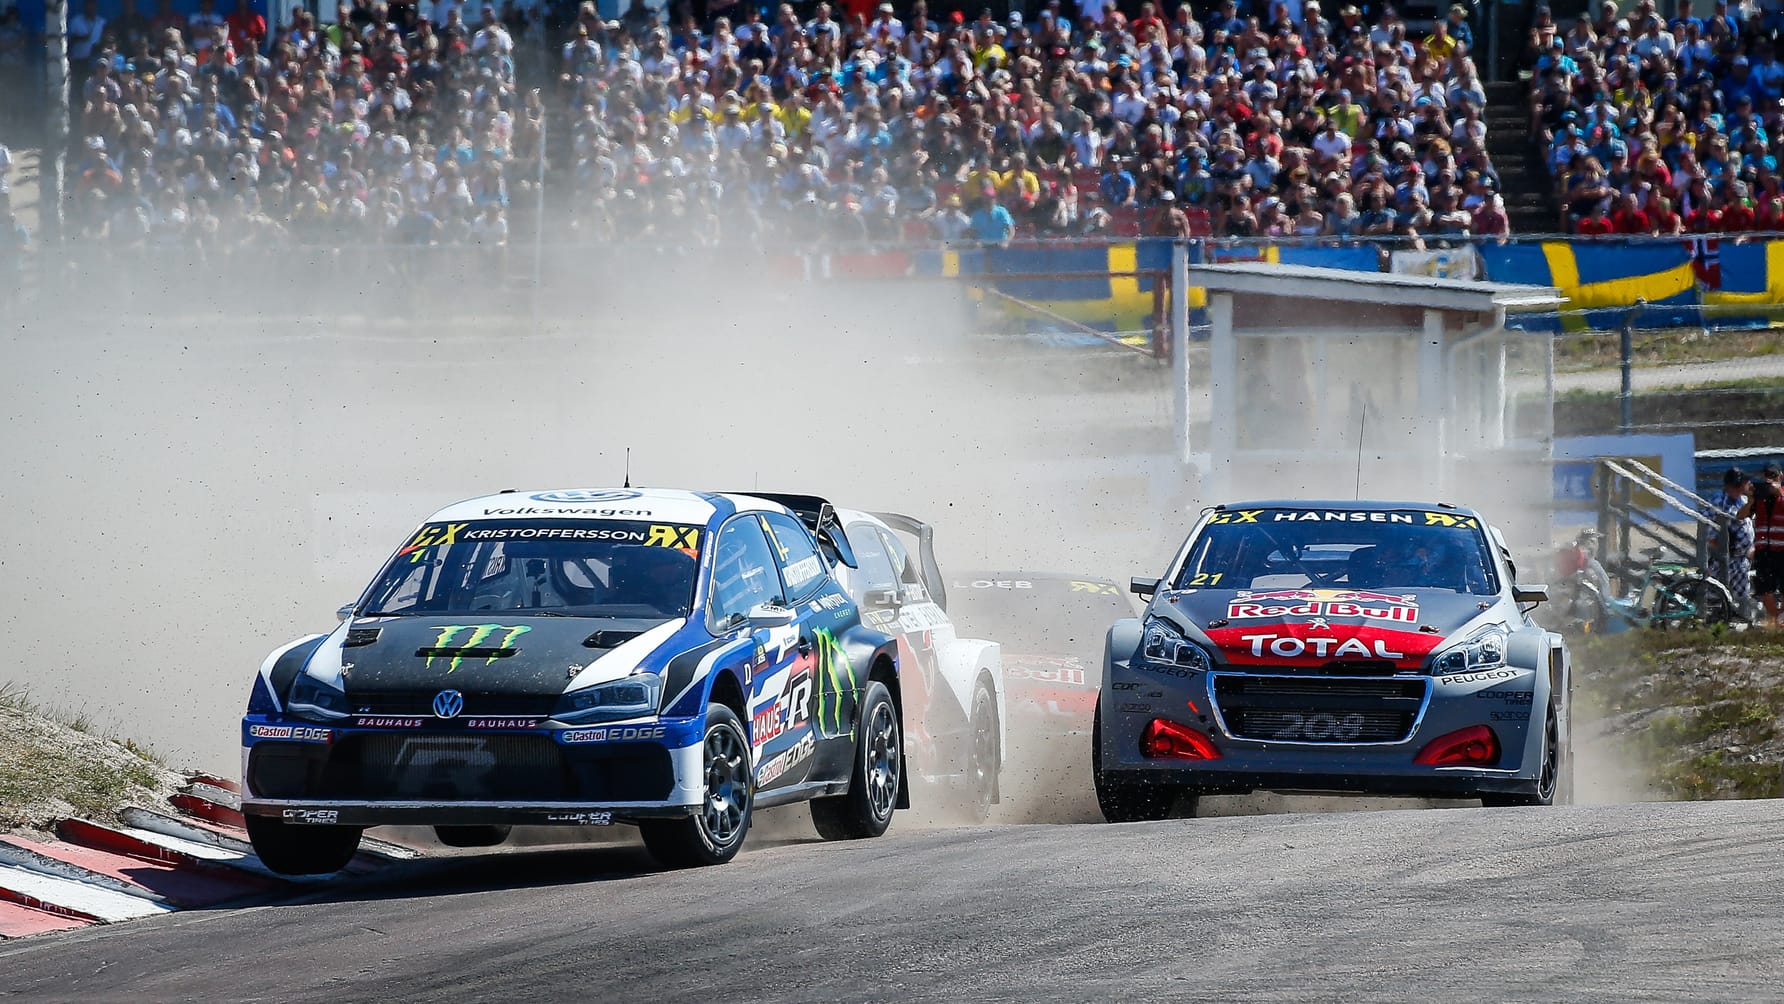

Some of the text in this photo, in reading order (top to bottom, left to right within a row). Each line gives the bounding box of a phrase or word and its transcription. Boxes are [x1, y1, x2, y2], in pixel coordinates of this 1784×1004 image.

[483, 508, 652, 517] Volkswagen
[1274, 511, 1413, 524] HANSEN
[463, 528, 645, 541] KRISTOFFERSSON
[409, 548, 427, 563] 1
[952, 580, 1033, 589] LOEB
[1190, 573, 1224, 586] 21
[1228, 601, 1419, 623] Red Bull
[1241, 633, 1404, 659] TOTAL
[1441, 670, 1519, 686] PEUGEOT
[1477, 691, 1534, 700] COOPER
[358, 718, 424, 727] BAUHAUS
[468, 719, 537, 727] BAUHAUS
[1272, 713, 1365, 740] 208
[257, 726, 331, 740] Castrol EDGE
[573, 727, 667, 742] Castrol EDGE
[783, 730, 816, 773] EDGE
